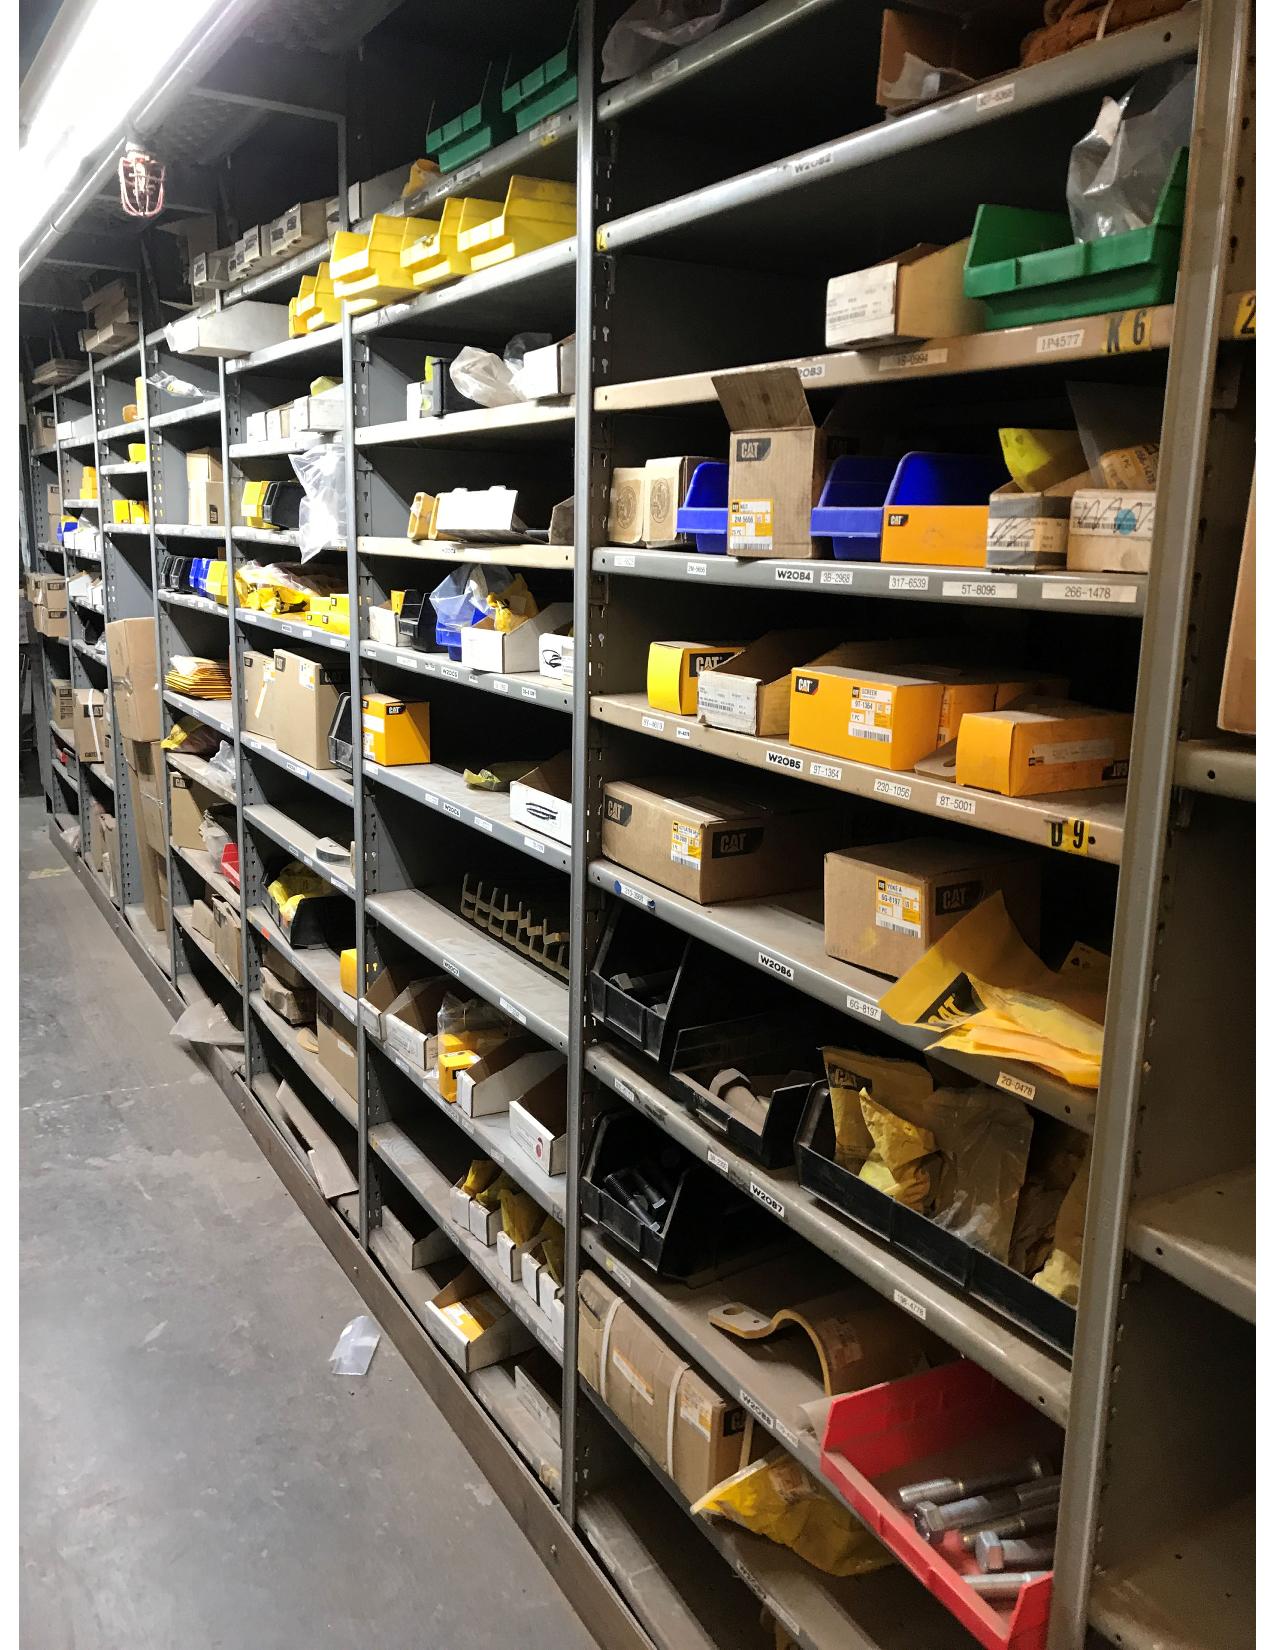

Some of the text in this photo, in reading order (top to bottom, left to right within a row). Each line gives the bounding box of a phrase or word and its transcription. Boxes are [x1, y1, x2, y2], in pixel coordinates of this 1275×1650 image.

[1133, 310, 1146, 346] 6
[741, 441, 759, 459] CAT
[890, 515, 903, 526] CAT
[891, 577, 927, 589] 317-6539
[961, 584, 996, 596] 5T-8096
[1064, 585, 1111, 599] 266-1478
[696, 655, 718, 674] CAT
[798, 678, 811, 692] CAT
[388, 706, 400, 714] CAT
[813, 765, 840, 779] 9T-1364
[877, 781, 910, 798] 230-1056
[607, 800, 622, 822] CAT
[940, 795, 972, 812] 8T-5001
[1073, 820, 1085, 849] 9
[720, 833, 747, 854] CAT
[943, 887, 967, 910] CAT
[849, 999, 879, 1018] 6G-8197
